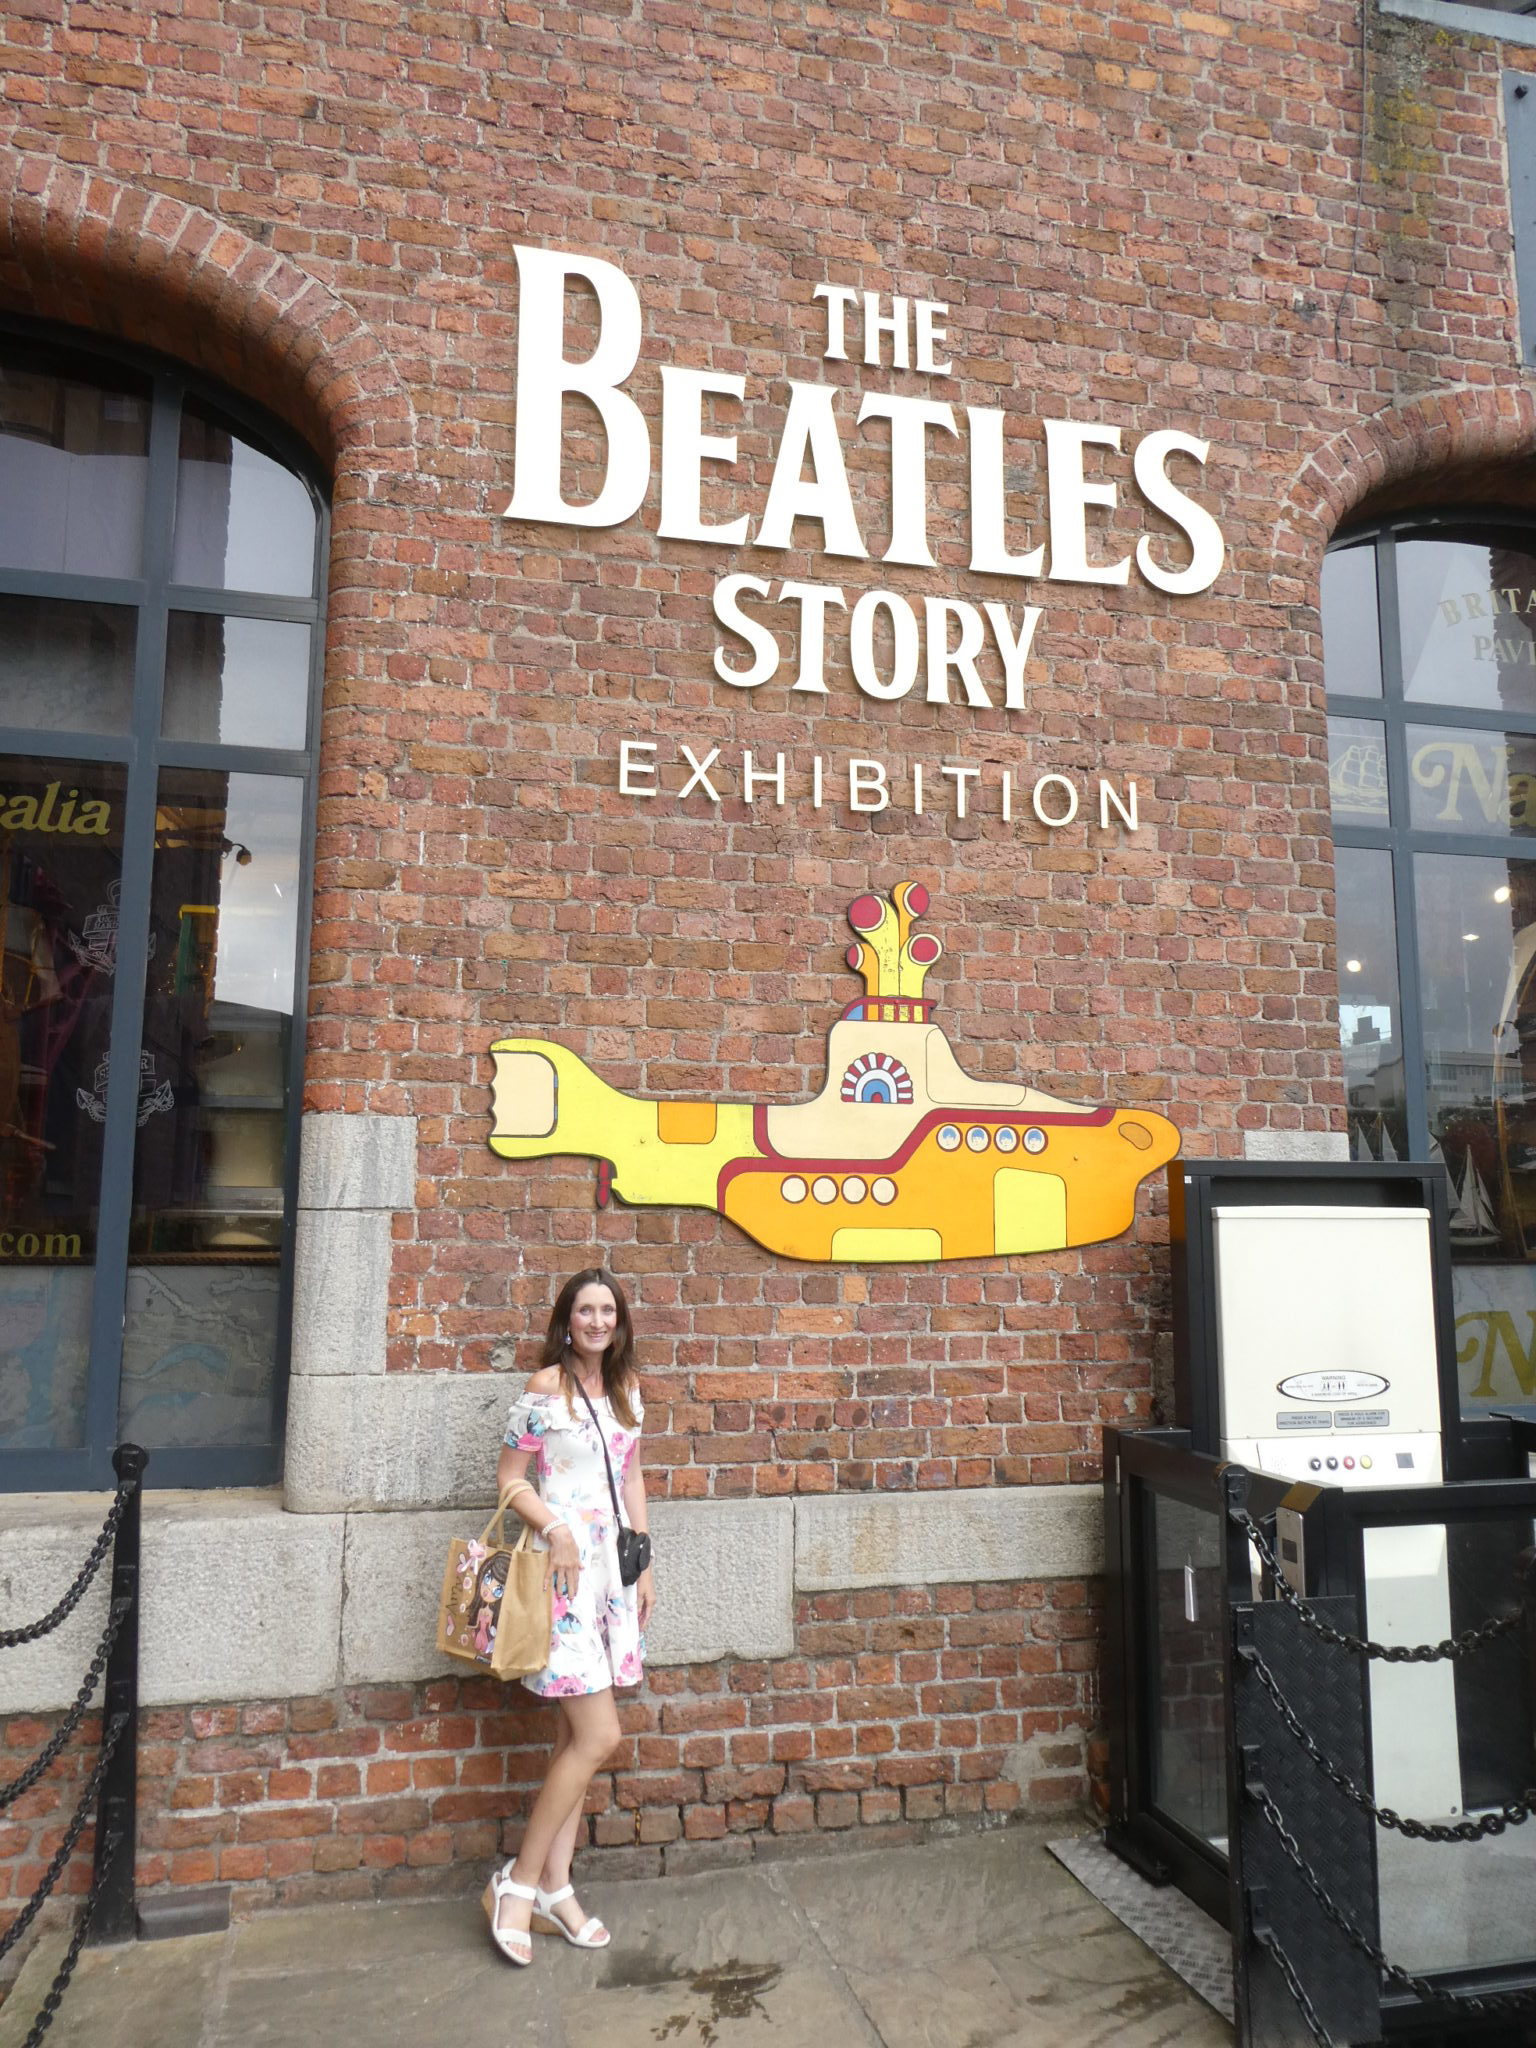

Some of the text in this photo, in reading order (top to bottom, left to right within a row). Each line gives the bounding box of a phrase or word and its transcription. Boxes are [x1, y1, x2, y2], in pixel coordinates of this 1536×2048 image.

[813, 284, 953, 375] THE
[503, 245, 1225, 595] BEATLES
[713, 574, 1044, 710] STORY
[0, 781, 111, 836] alia
[619, 740, 1139, 831] EXHIBITION
